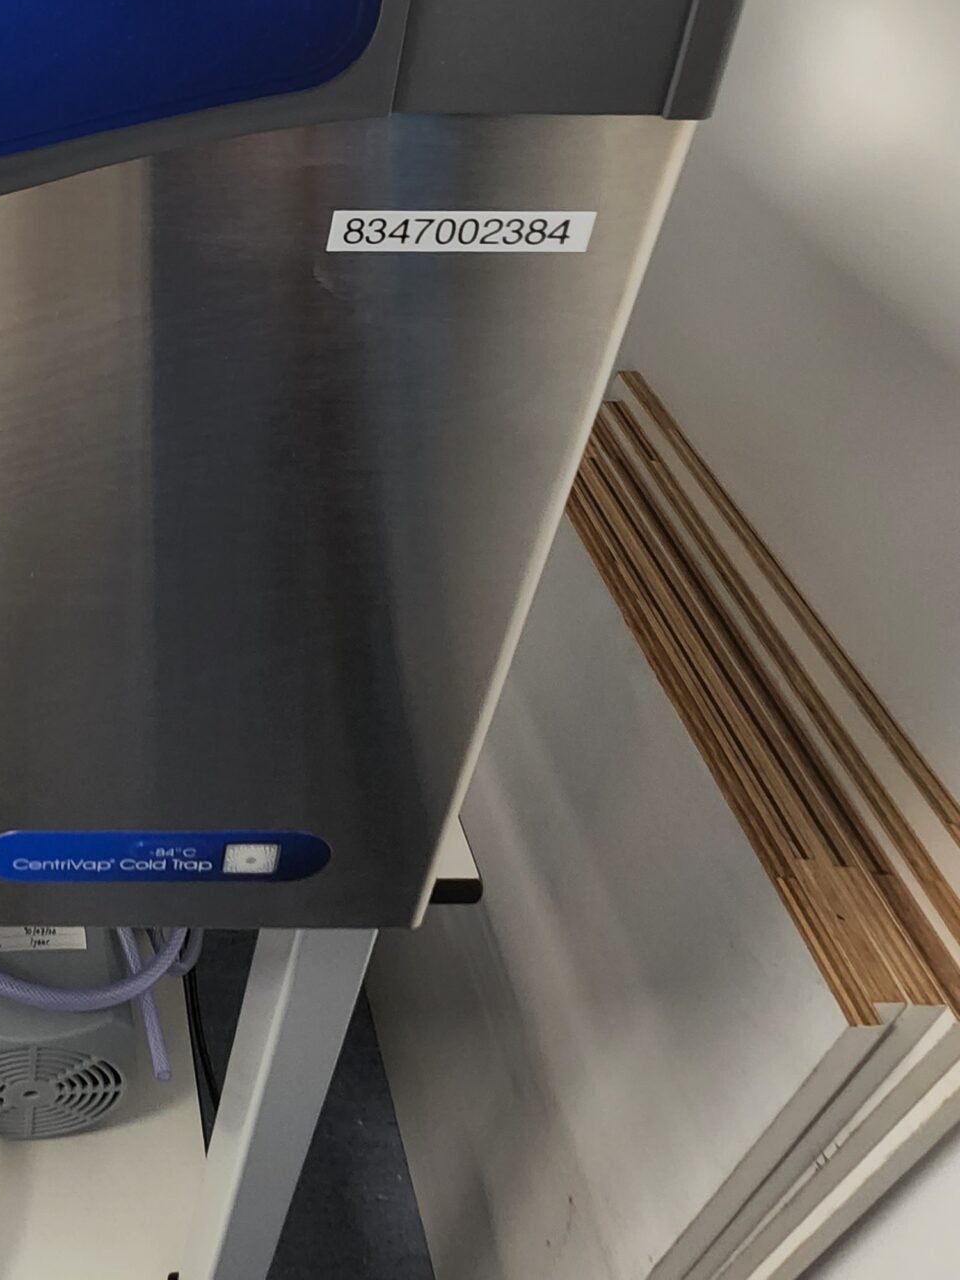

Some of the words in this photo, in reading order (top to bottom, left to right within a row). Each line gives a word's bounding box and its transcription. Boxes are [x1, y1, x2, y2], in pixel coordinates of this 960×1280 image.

[343, 218, 571, 245] 8347002384
[120, 858, 166, 871] Cold
[172, 858, 213, 872] Trap
